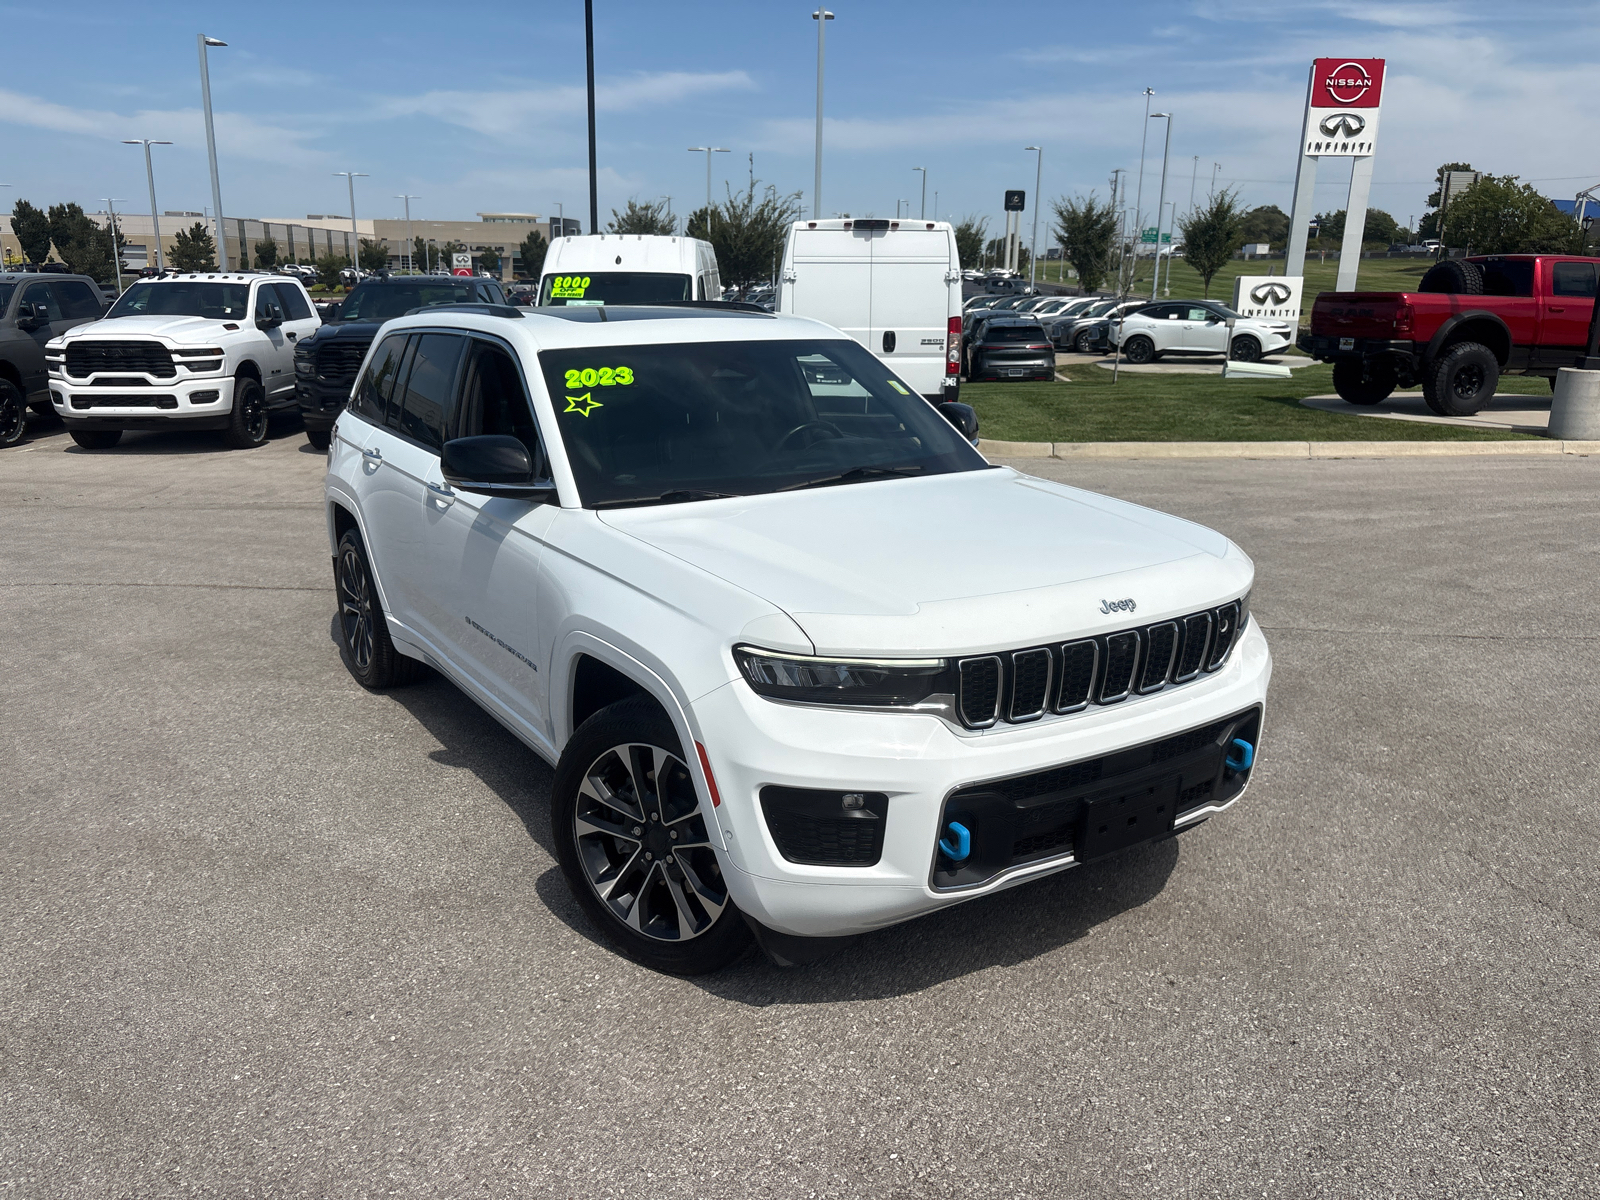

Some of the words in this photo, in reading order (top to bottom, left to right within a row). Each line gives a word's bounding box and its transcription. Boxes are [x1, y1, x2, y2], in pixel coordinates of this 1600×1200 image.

[1325, 78, 1372, 86] NISSAN
[1306, 141, 1372, 153] INFINITI
[553, 276, 591, 289] 8000
[1241, 309, 1296, 317] INFINITI
[564, 366, 635, 389] 2023
[1099, 598, 1137, 615] Jeep
